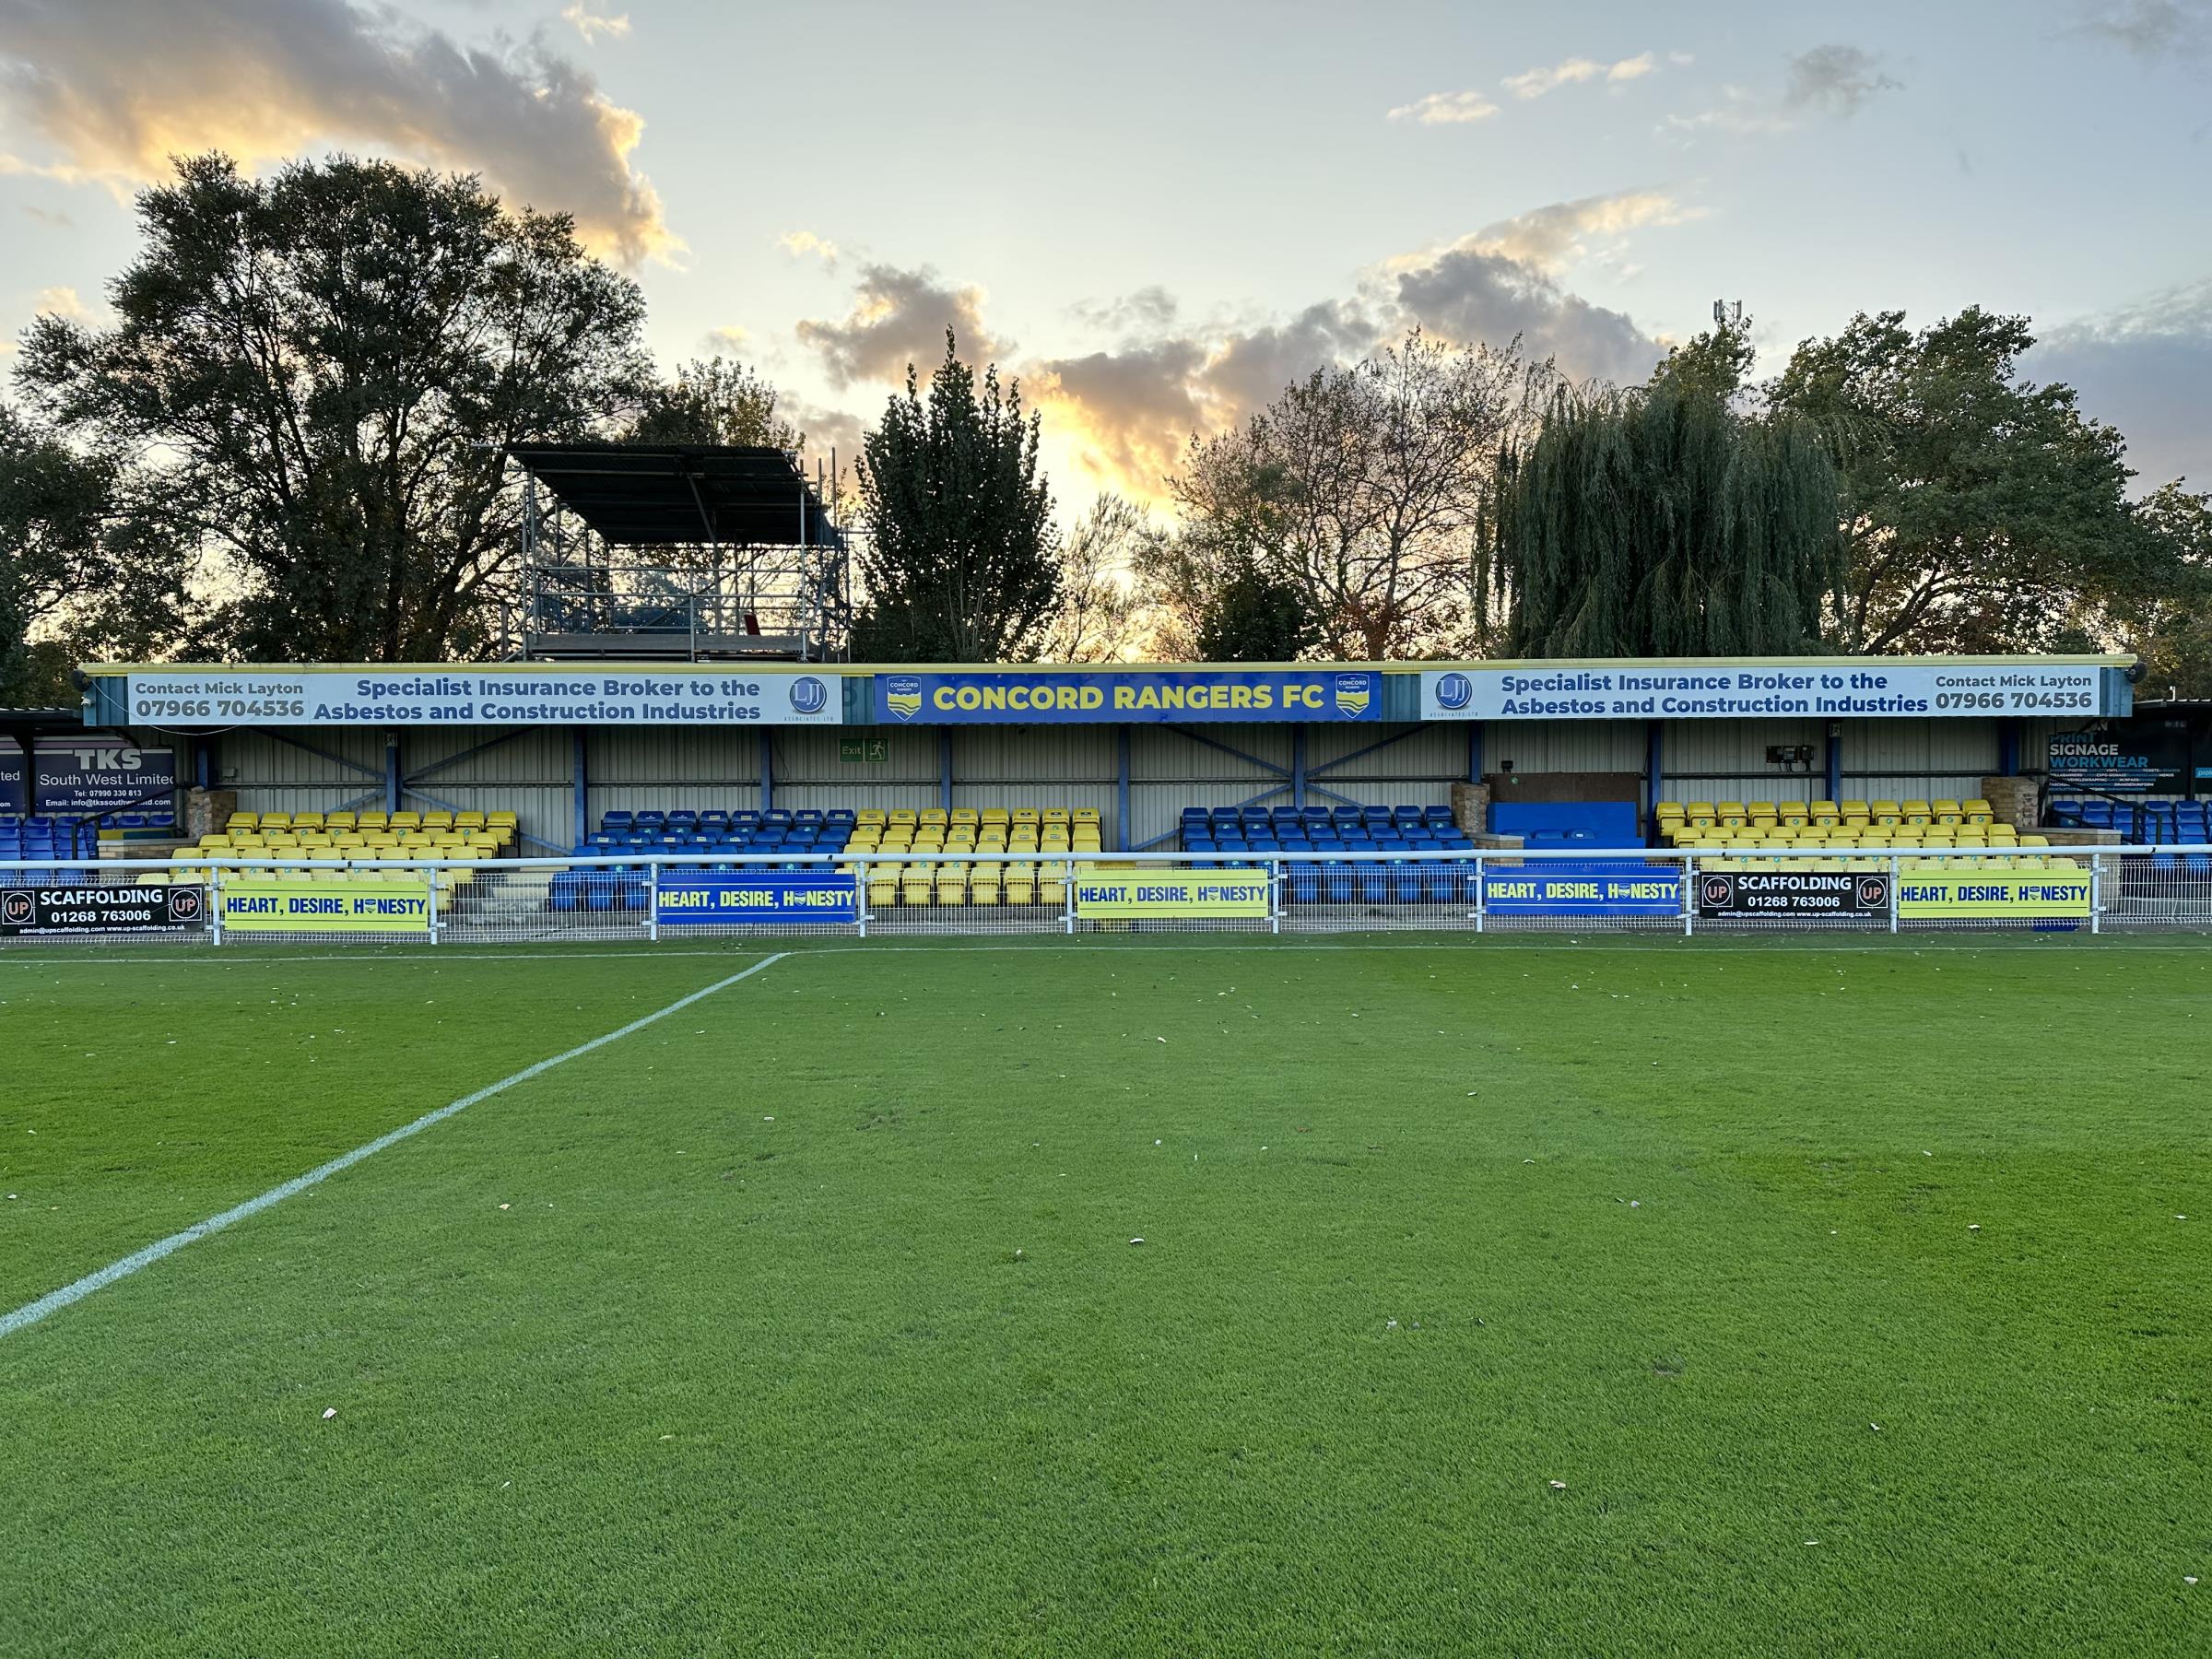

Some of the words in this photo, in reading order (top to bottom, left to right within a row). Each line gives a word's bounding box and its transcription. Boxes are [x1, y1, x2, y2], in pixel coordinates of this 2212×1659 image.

[135, 683, 200, 694] Contact
[205, 682, 243, 694] Mick
[248, 683, 303, 696] Layton
[357, 678, 472, 700] Specialist
[479, 679, 596, 696] Insurance
[603, 679, 684, 696] Broker
[689, 681, 715, 696] to
[721, 679, 760, 696] the
[1440, 679, 1468, 701] LJJ
[1501, 673, 1612, 695] Specialist
[1618, 675, 1731, 690] Insurance
[1737, 673, 1815, 689] Broker
[1820, 676, 1843, 689] to
[1850, 673, 1888, 689] the
[1936, 676, 1995, 688] Contact
[2000, 676, 2035, 687] Mick
[2041, 676, 2091, 688] Layton
[792, 683, 822, 706] LJJ
[933, 686, 1104, 710] CONCORD
[1113, 685, 1273, 709] RANGERS
[1282, 685, 1324, 708] FC
[1936, 692, 2005, 709] 07966
[2010, 692, 2092, 709] 704536
[135, 700, 210, 717] 07966
[218, 700, 304, 717] 704536
[313, 703, 421, 720] Asbestos
[429, 702, 474, 719] and
[480, 700, 635, 719] Construction
[642, 700, 760, 719] Industries
[1501, 698, 1606, 714] Asbestos
[1612, 697, 1654, 713] and
[1662, 694, 1809, 713] Construction
[1816, 694, 1928, 712] Industries
[841, 747, 862, 755] Exit
[2049, 744, 2119, 756] SIGNAGE
[74, 748, 142, 771] TKS
[2049, 756, 2148, 768] WORKWEAR
[40, 773, 81, 786] South
[86, 773, 122, 785] West
[1488, 883, 1542, 900] HEART,
[1546, 883, 1604, 901] DESIRE,
[1607, 883, 1678, 900] HNESTY
[1738, 877, 1852, 890] SCAFFOLDING
[40, 889, 163, 906] SCAFFOLDING
[659, 891, 715, 909] HEART,
[720, 890, 780, 909] DESIRE,
[784, 890, 854, 907] HNESTY
[1079, 887, 1132, 904] HEART,
[1136, 887, 1194, 904] DESIRE,
[1198, 886, 1265, 901] HNESTY
[1707, 886, 1727, 899] UP
[1862, 887, 1882, 900] UP
[1900, 887, 1952, 903] HEART,
[1958, 886, 2014, 903] DESIRE,
[2018, 886, 2088, 901] HNESTY
[8, 901, 29, 915] UP
[175, 899, 196, 912] UP
[227, 897, 284, 916] HEART,
[288, 898, 349, 917] DESIRE,
[354, 899, 426, 914] HNESTY
[1747, 897, 1788, 907] 01268
[1792, 897, 1841, 907] 763006
[51, 912, 96, 923] 01268
[101, 911, 151, 922] 763006
[19, 926, 105, 935] admin@upscaffolding.com
